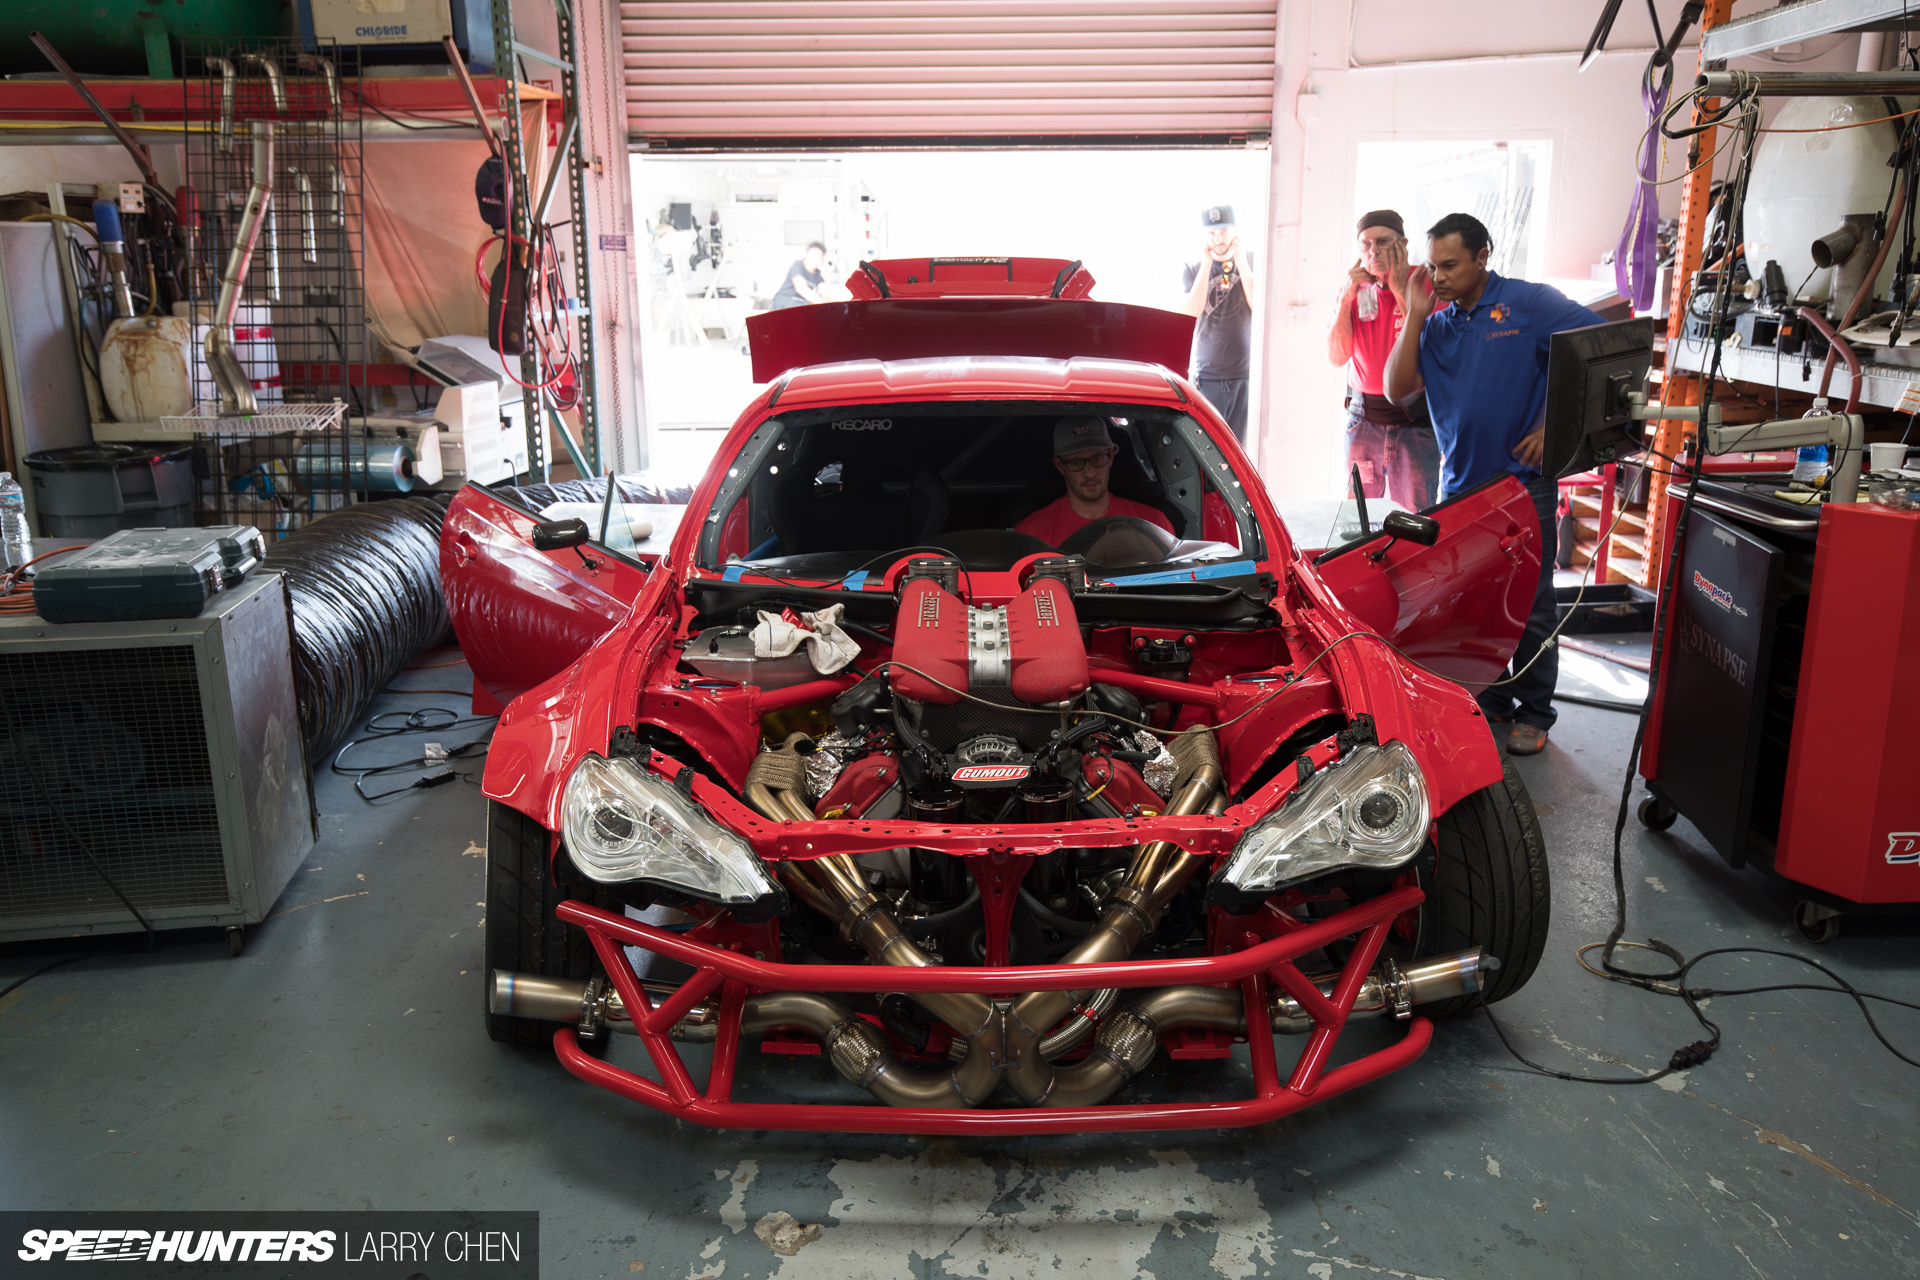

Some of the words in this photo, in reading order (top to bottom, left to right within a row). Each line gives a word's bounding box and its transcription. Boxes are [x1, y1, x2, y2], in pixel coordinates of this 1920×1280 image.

[355, 25, 407, 36] CHLORIDE
[1492, 329, 1520, 338] SYNAPSE
[832, 419, 892, 431] RECARO
[1694, 570, 1732, 606] Dynapack
[1691, 624, 1747, 686] SYNAPSE
[959, 768, 1026, 778] GUMOUT
